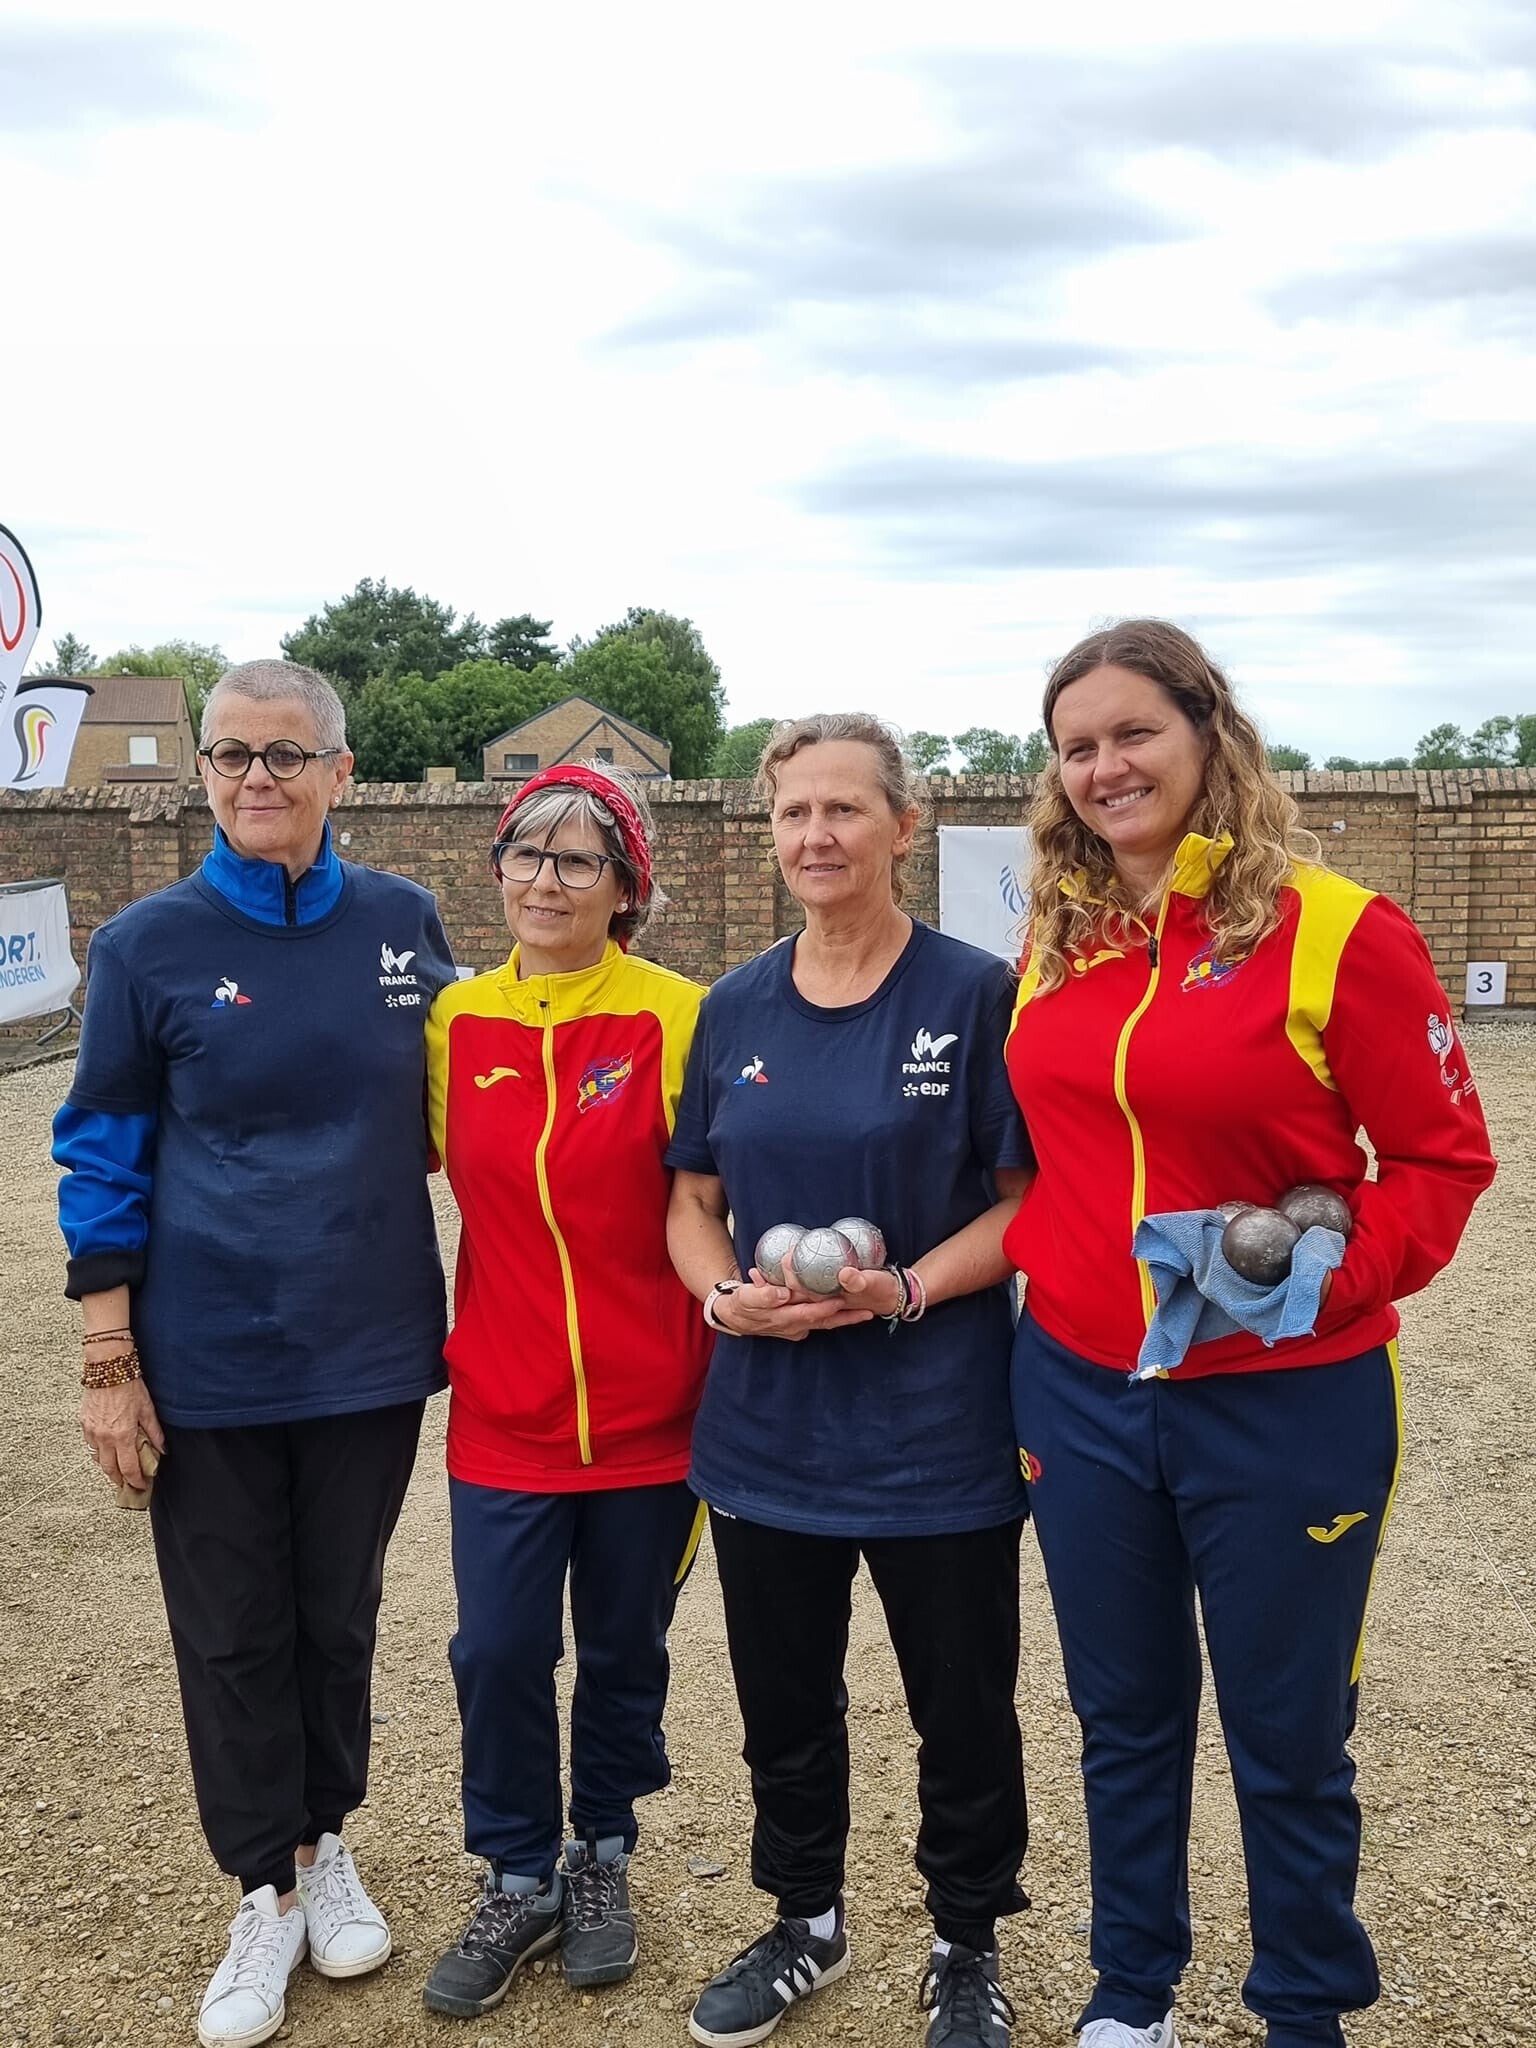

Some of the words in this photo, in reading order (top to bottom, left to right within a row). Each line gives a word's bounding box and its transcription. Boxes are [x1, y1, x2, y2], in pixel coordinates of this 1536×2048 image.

[379, 975, 418, 986] FRANCE
[1476, 971, 1493, 993] 3
[902, 1061, 951, 1074] FRANCE
